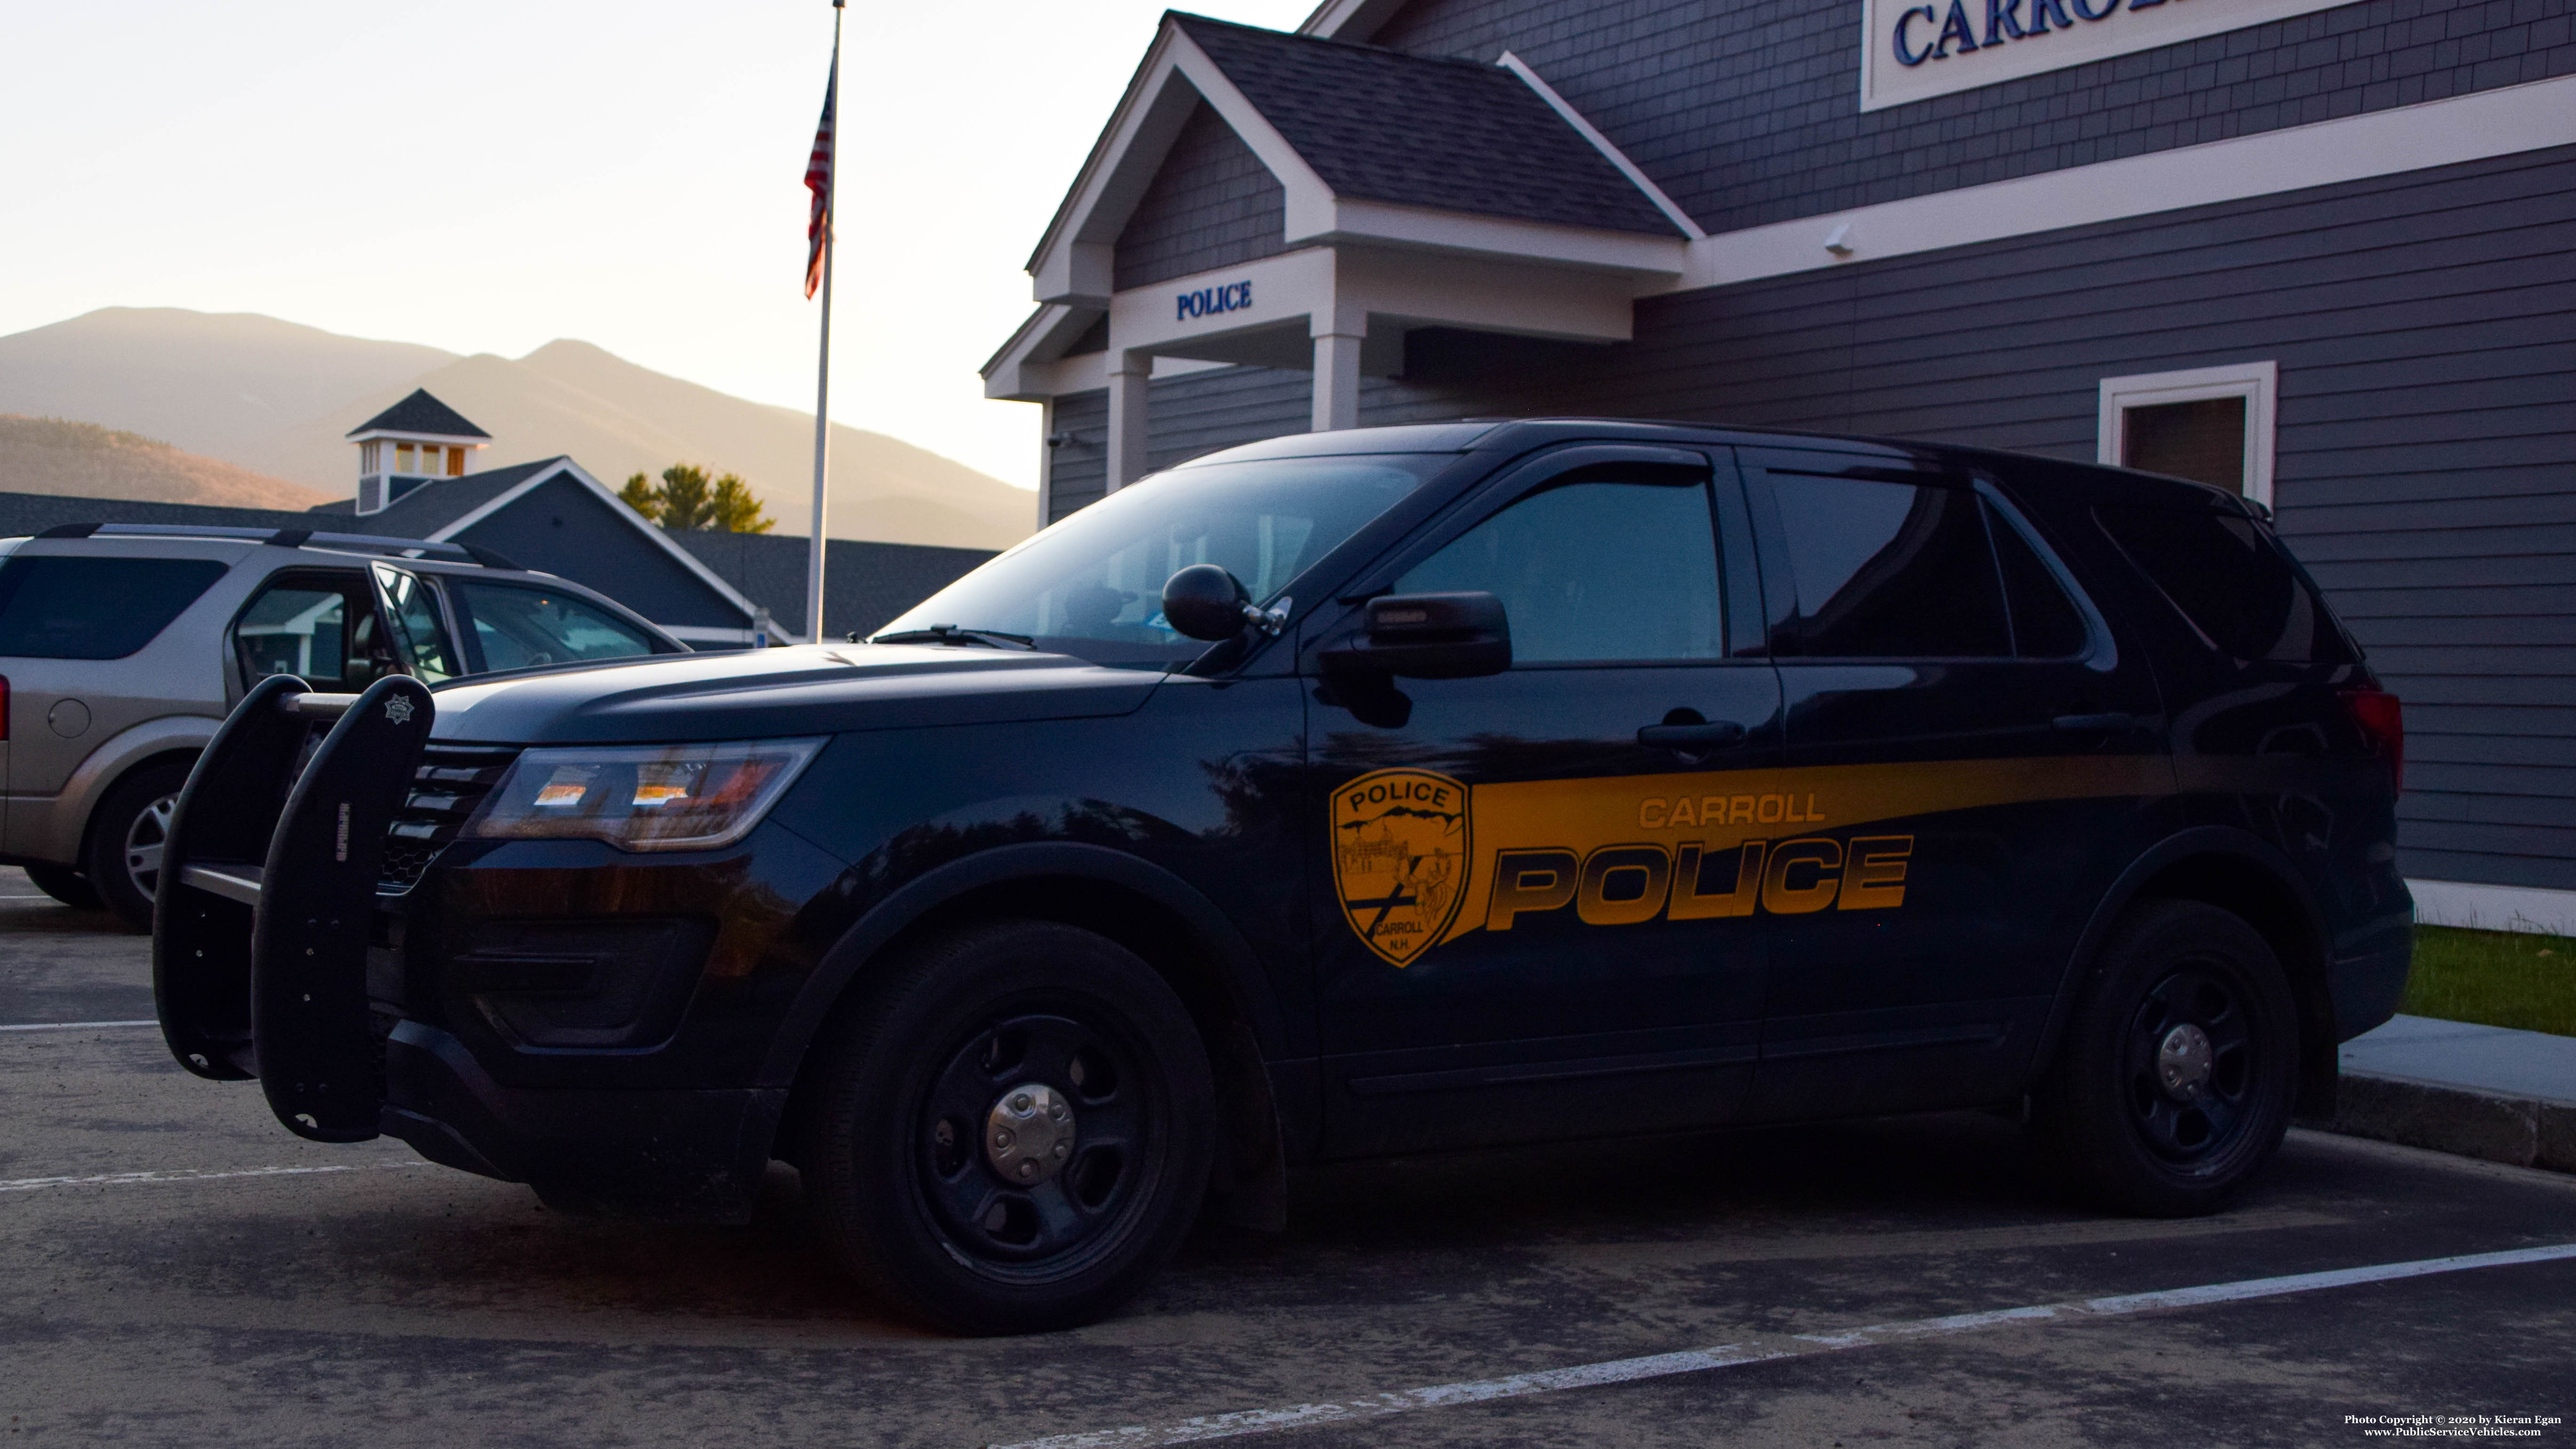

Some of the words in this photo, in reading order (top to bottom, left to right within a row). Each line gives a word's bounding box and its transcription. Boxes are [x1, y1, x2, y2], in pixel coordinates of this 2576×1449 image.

[1177, 280, 1251, 320] POLICE
[1350, 781, 1449, 812] POLICE
[1638, 792, 1826, 829] CARROLL
[1486, 835, 1914, 931] POLICE
[1375, 921, 1424, 936] CARROLL
